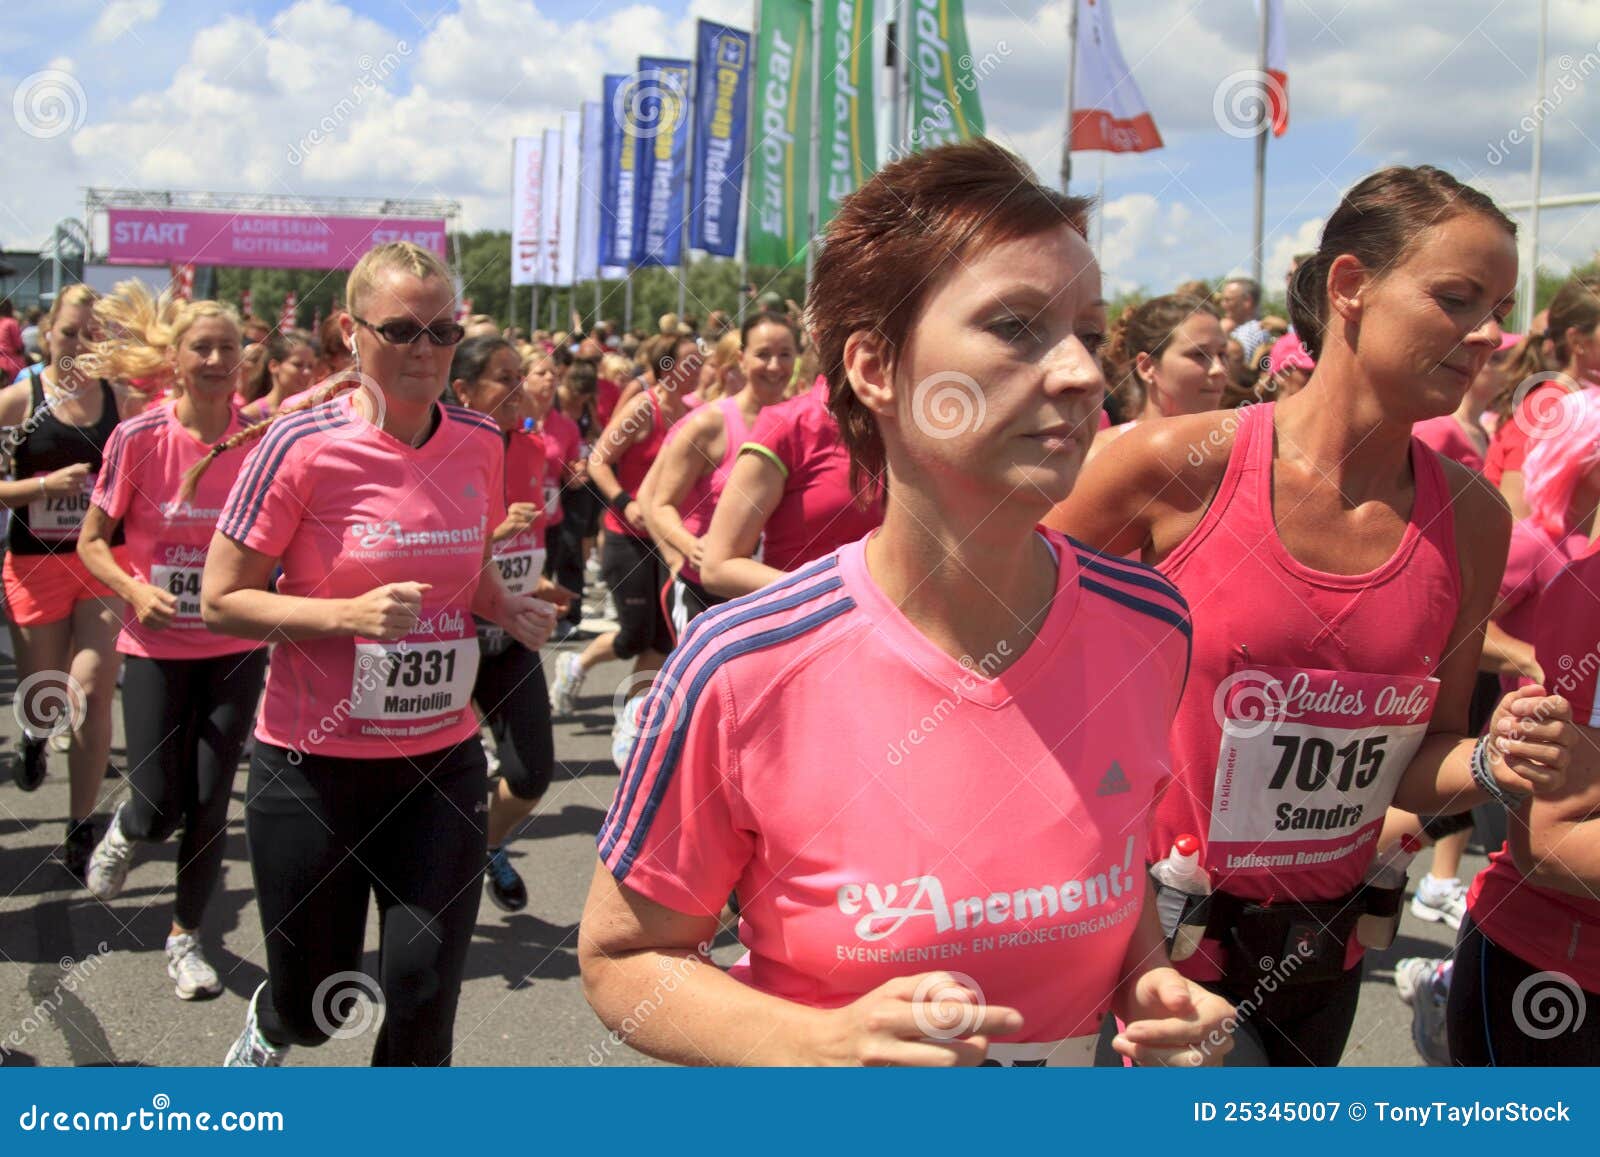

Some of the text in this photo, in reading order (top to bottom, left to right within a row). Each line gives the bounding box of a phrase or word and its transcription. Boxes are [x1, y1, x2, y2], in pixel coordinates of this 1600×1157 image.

[760, 28, 795, 238] Europcar
[114, 221, 189, 246] START
[440, 610, 464, 638] Only
[386, 648, 456, 687] 7331
[384, 692, 452, 714] Marjolijn
[1263, 672, 1430, 724] Ladies Only
[1219, 747, 1238, 813] 10 kilometer
[1268, 735, 1388, 792] 7015
[1275, 802, 1364, 831] Sandra
[1226, 852, 1293, 869] Ladiesrun
[1295, 842, 1354, 866] Rotterdam
[836, 834, 1136, 941] evAnement!
[836, 944, 968, 963] EVENEMENTEN-
[973, 935, 995, 953] EN
